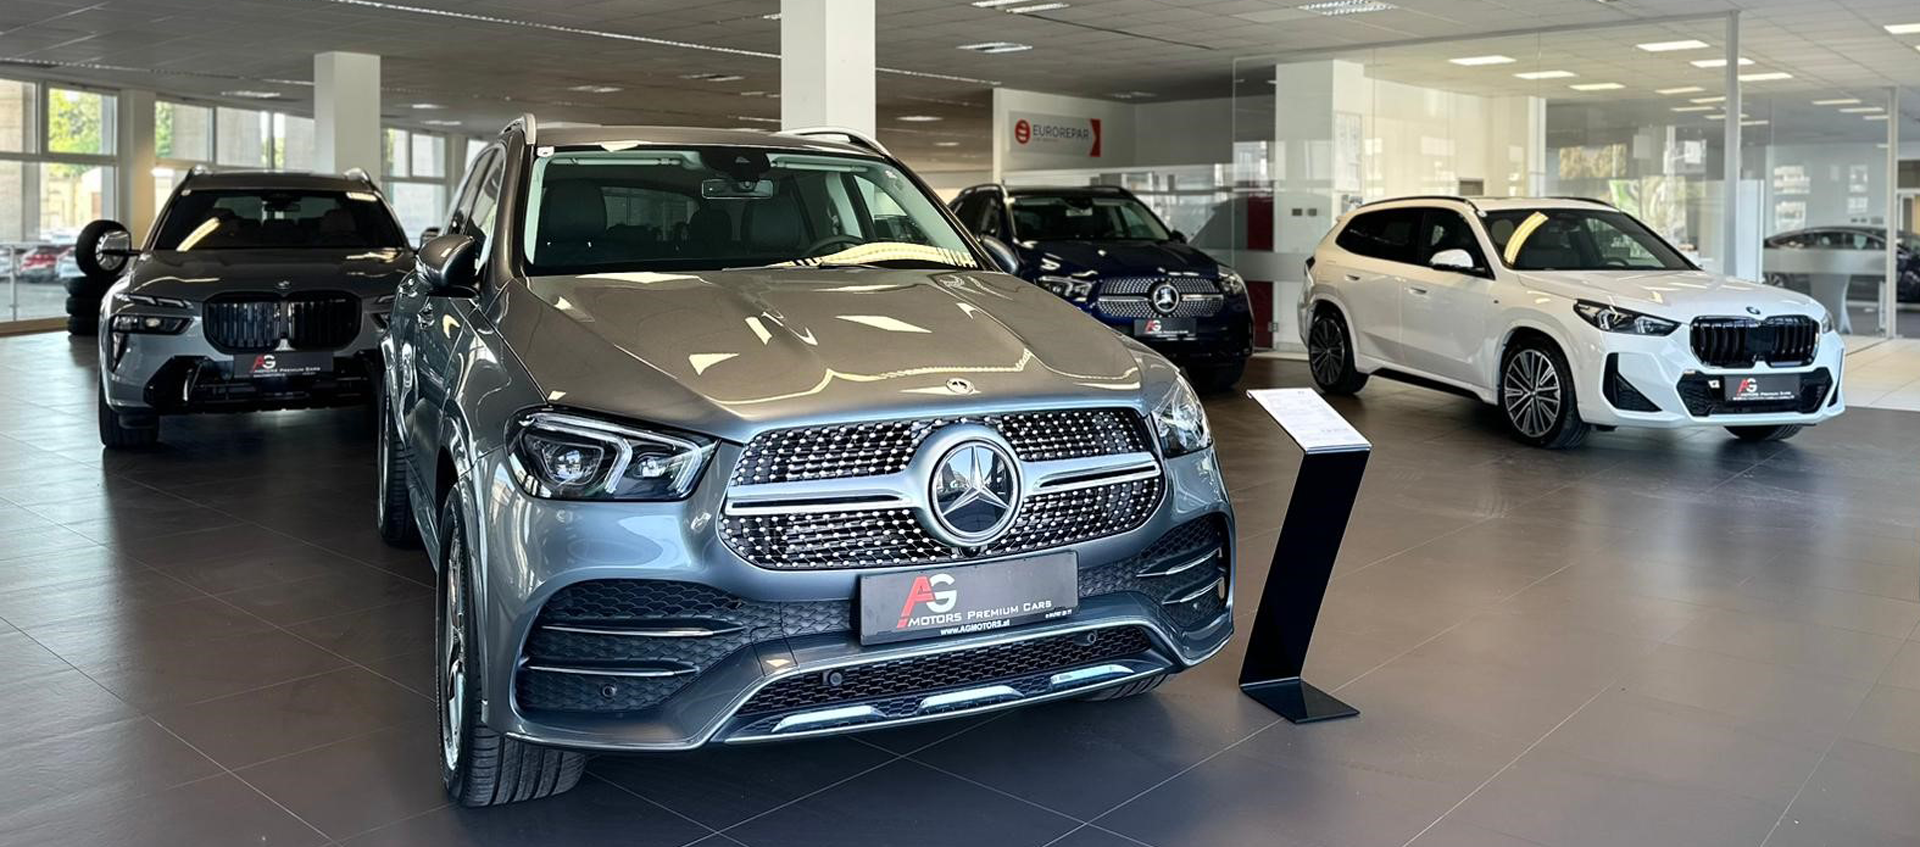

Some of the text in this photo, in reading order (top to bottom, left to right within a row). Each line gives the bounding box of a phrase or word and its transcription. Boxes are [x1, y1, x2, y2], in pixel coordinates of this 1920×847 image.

[1033, 124, 1089, 139] EUROREPAR
[252, 354, 276, 371] AG
[1737, 378, 1758, 394] AG
[897, 573, 957, 629] AG
[907, 612, 962, 628] MOTORS
